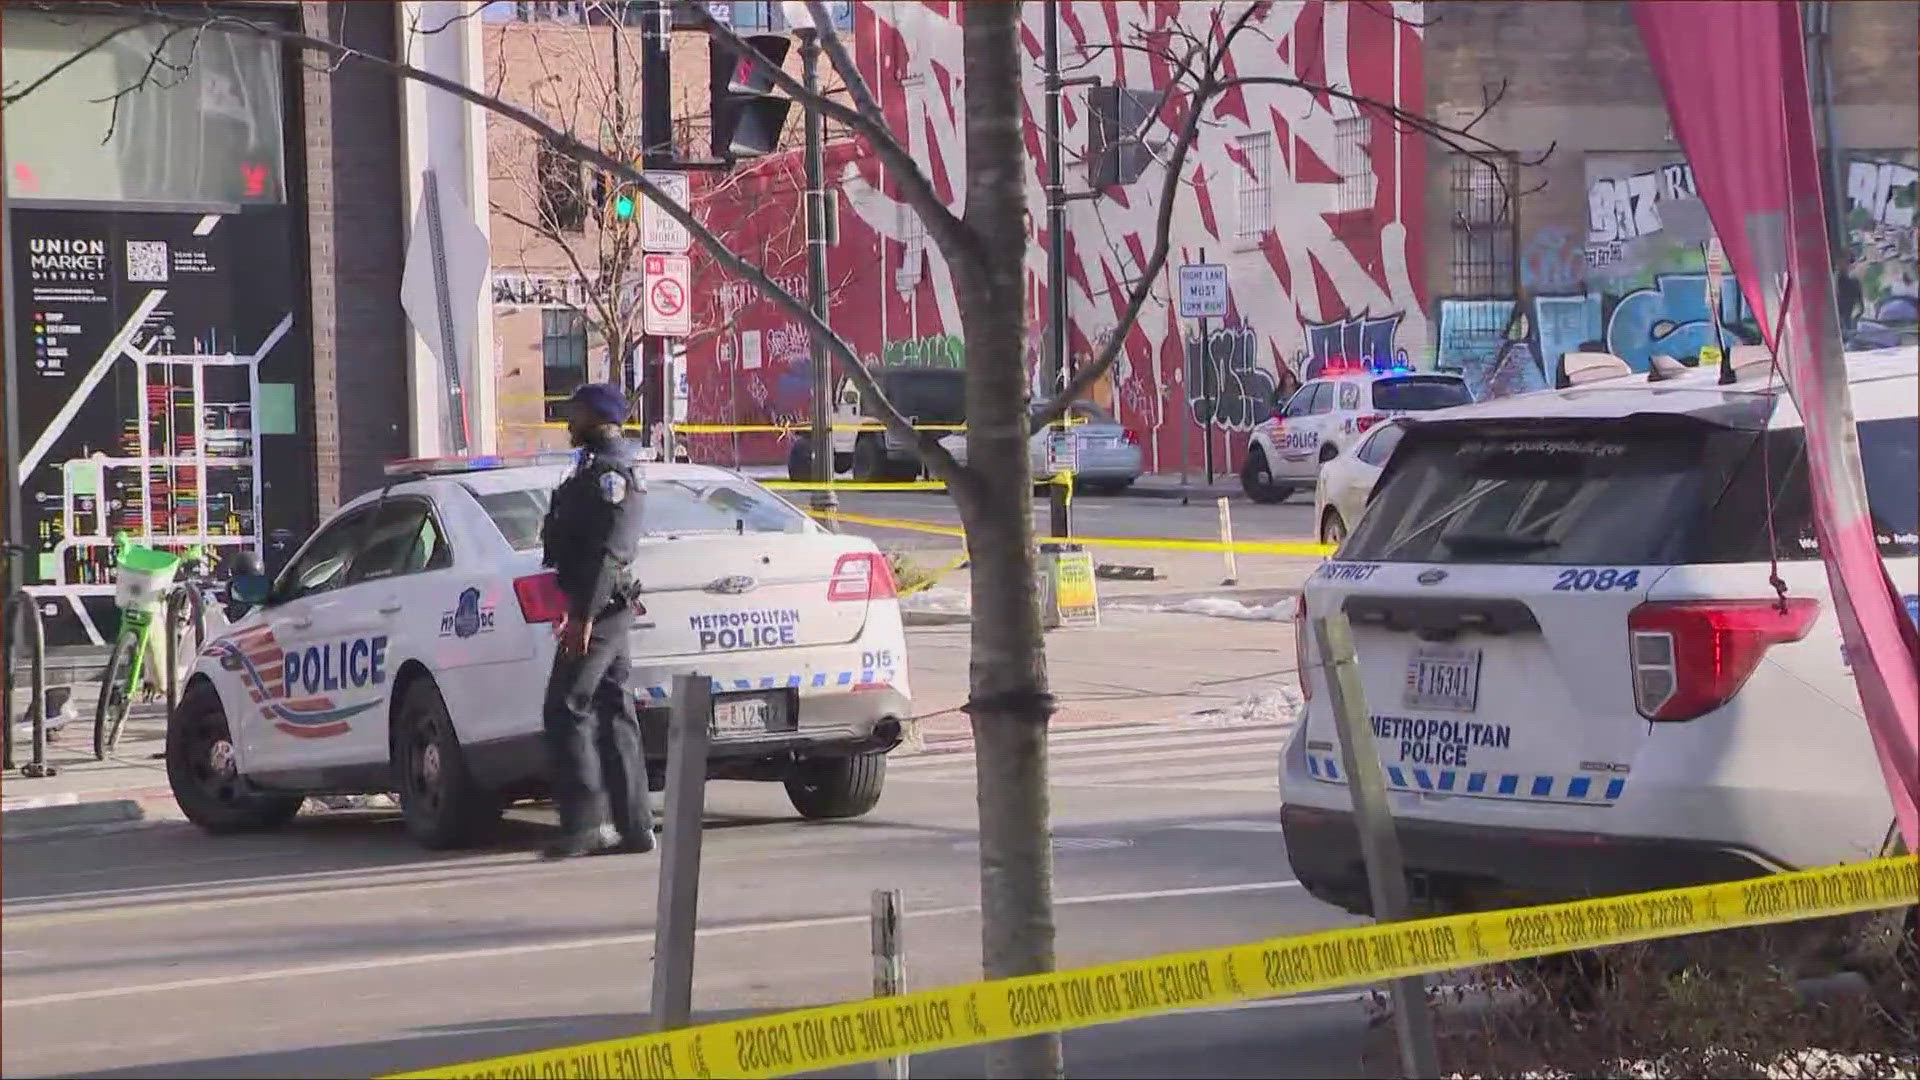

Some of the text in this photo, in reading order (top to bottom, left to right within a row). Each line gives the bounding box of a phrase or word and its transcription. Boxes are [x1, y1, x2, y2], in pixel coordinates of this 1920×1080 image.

[31, 239, 104, 254] UNION
[31, 256, 105, 270] MARKET
[32, 272, 105, 281] DISTRICT
[1190, 285, 1215, 296] MUST
[1286, 432, 1318, 448] POLICE
[1552, 569, 1640, 591] 2084
[480, 612, 494, 626] DC
[690, 609, 800, 630] METROPOLITAN
[700, 625, 796, 650] POLICE
[284, 636, 388, 698] POLICE
[1371, 715, 1510, 748] METROPOLITAN
[1401, 740, 1468, 767] POLICE
